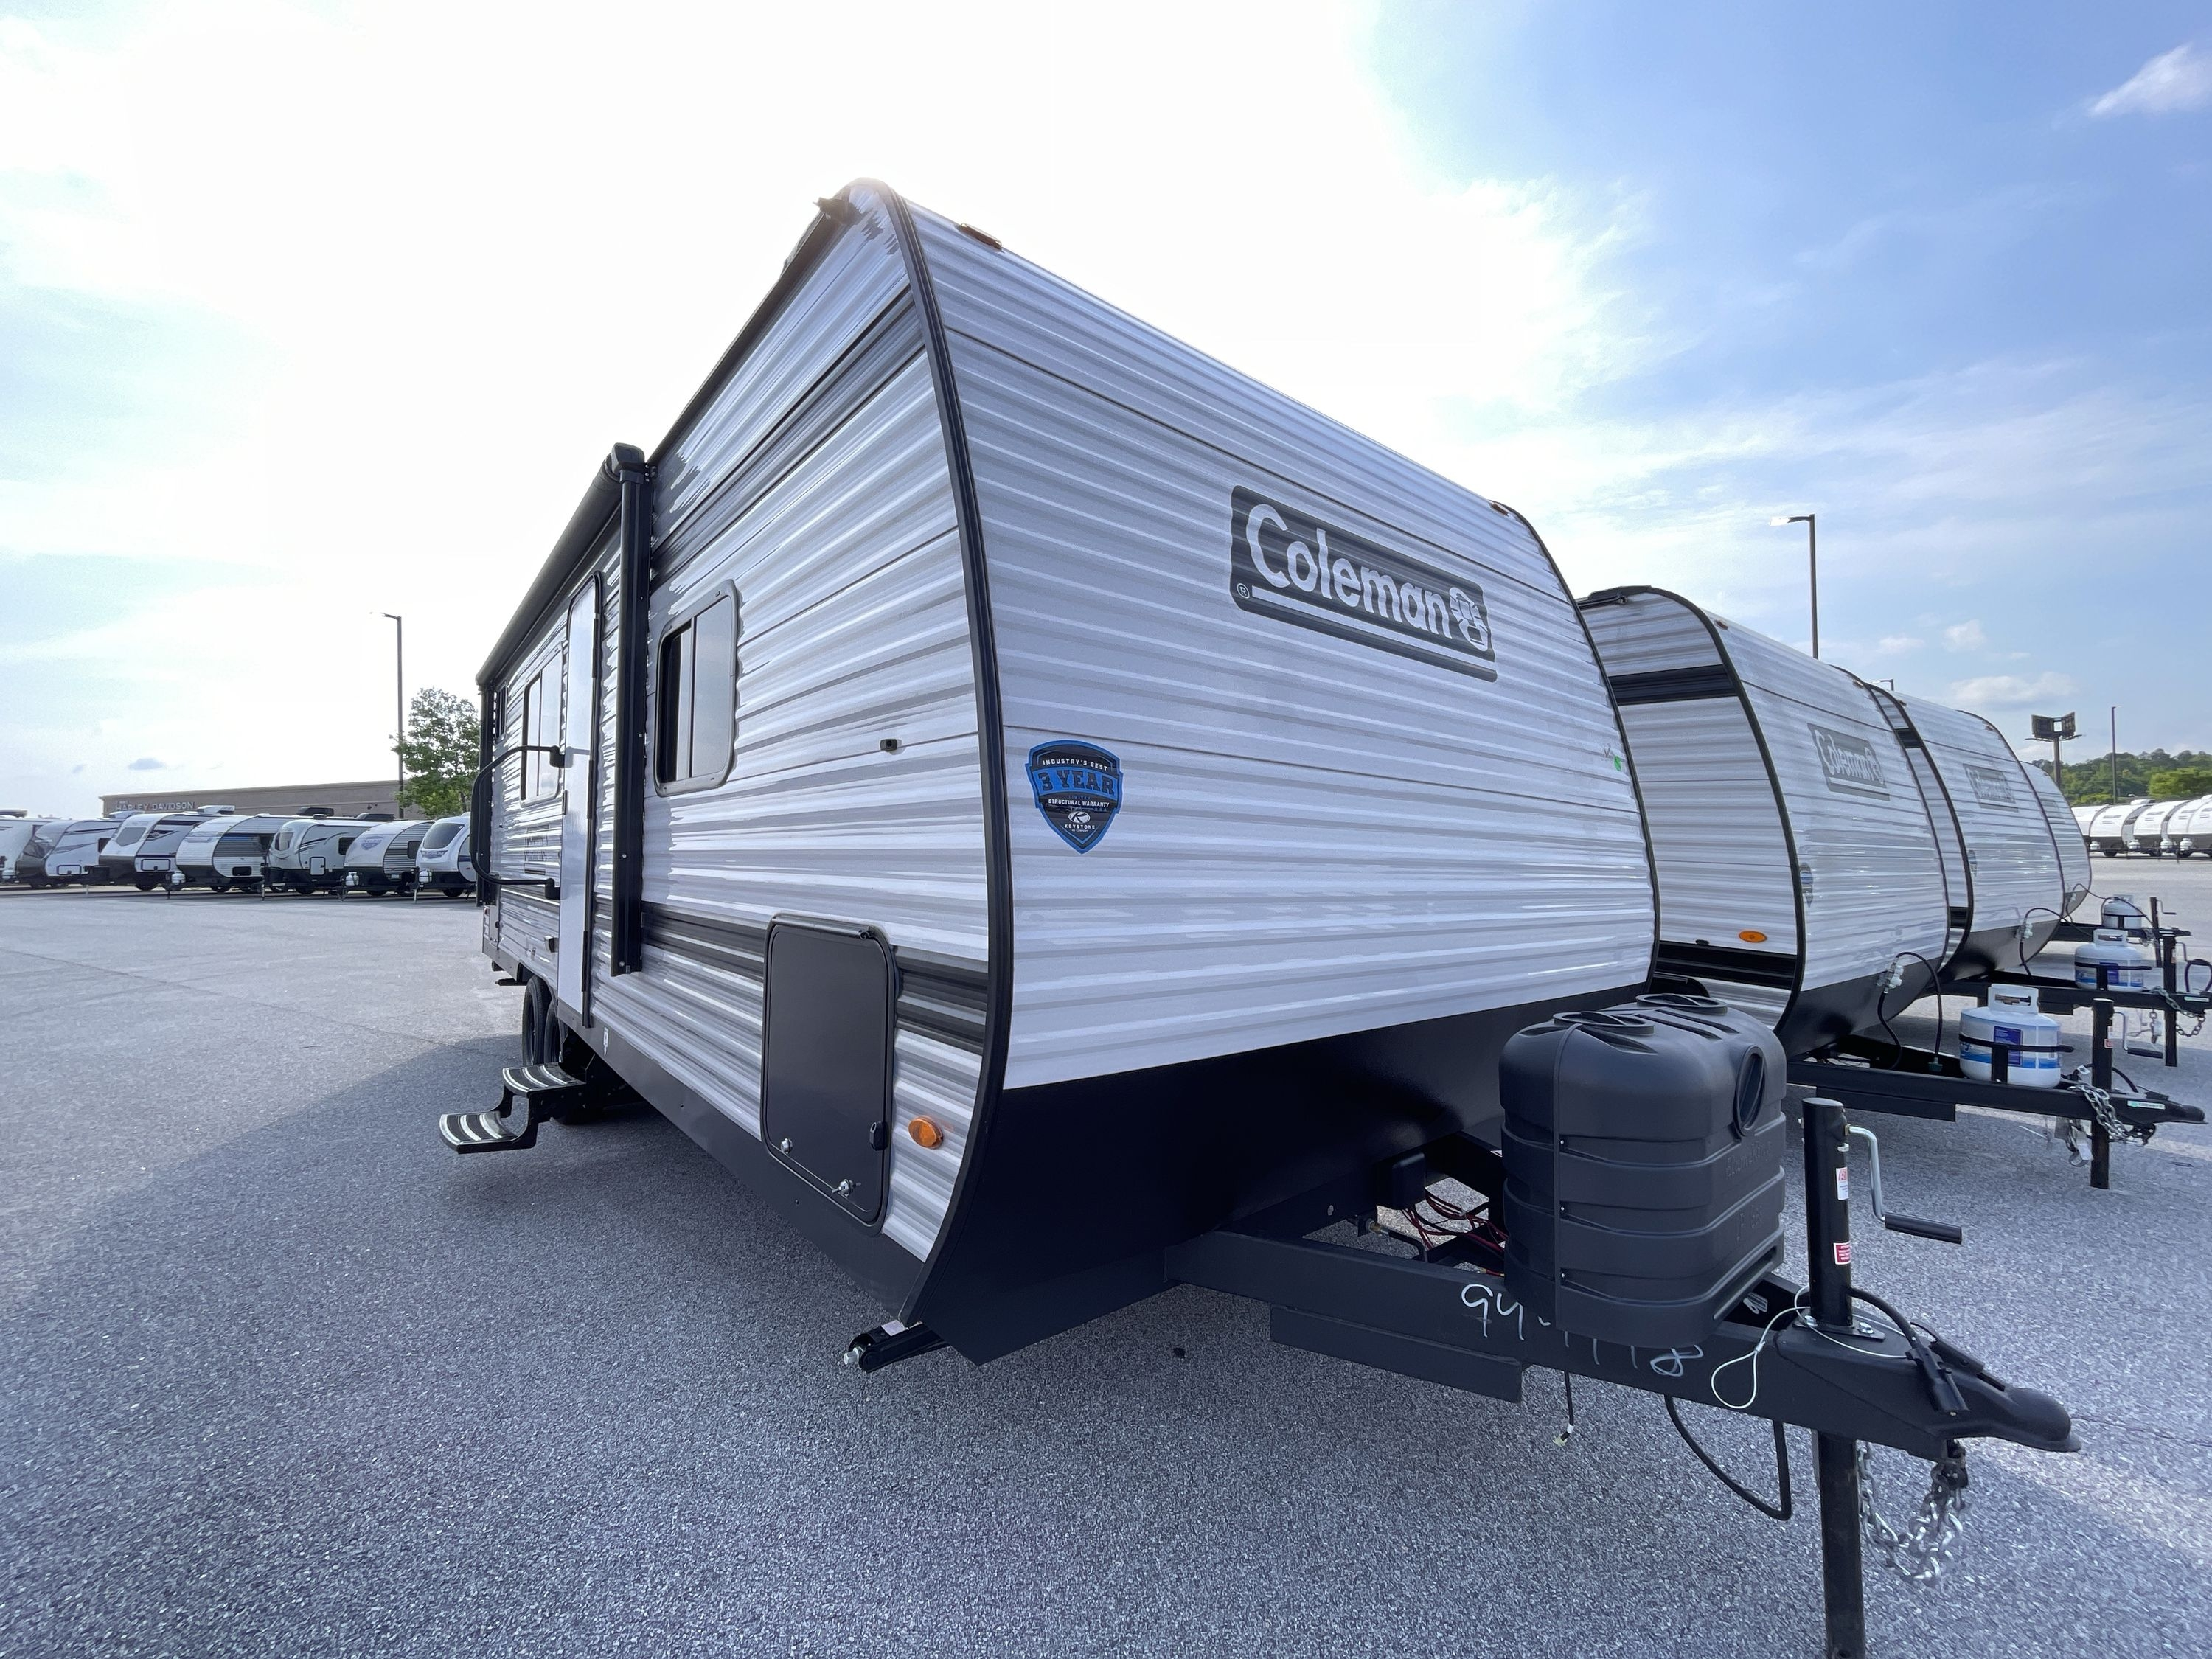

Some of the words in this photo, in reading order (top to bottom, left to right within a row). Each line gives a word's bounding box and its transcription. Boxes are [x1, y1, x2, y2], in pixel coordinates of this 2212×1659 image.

[1246, 504, 1453, 639] Coleman
[1043, 758, 1088, 766] INDUSTRY'S
[1090, 762, 1107, 771] BEST
[1038, 772, 1054, 791] 3
[1057, 769, 1115, 796] YEAR
